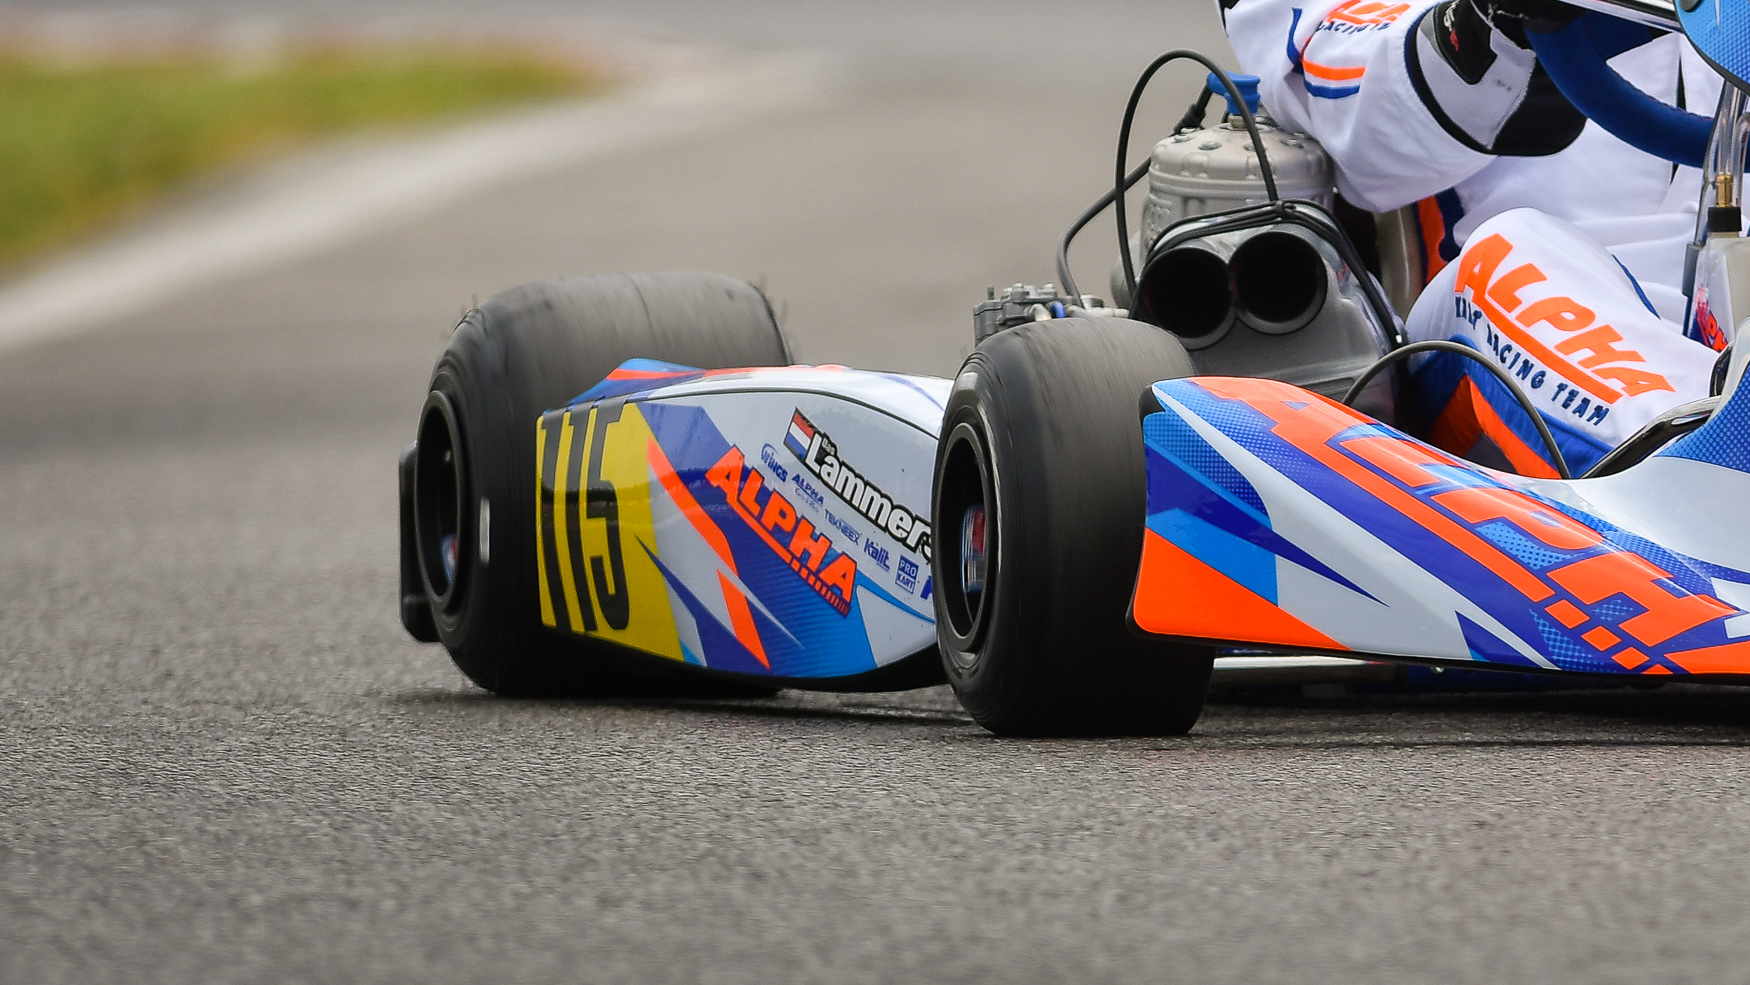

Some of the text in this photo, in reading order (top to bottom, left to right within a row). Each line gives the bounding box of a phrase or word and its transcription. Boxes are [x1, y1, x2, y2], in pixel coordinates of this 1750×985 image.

[1455, 233, 1677, 398] ALPHA
[1551, 382, 1610, 426] TEAM
[541, 395, 630, 633] 115
[704, 444, 858, 610] ALPHA
[791, 474, 824, 505] ALPHA
[899, 559, 918, 578] PRO
